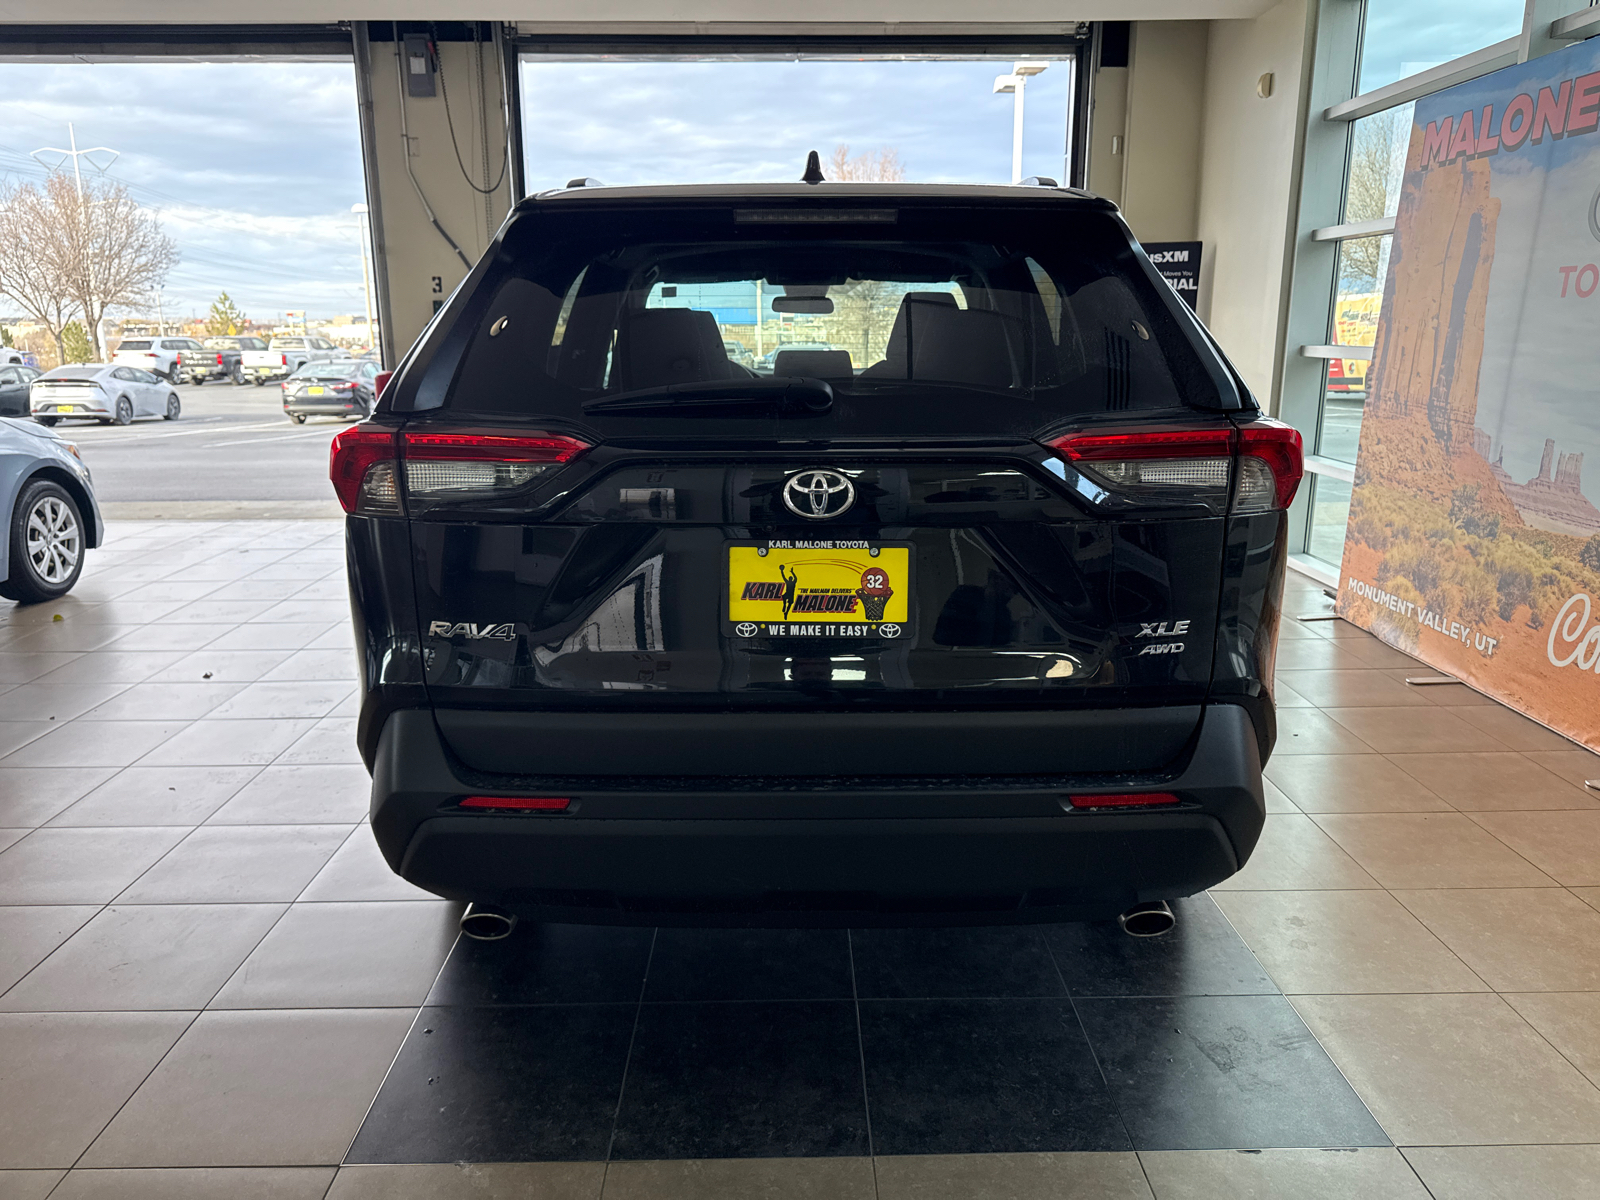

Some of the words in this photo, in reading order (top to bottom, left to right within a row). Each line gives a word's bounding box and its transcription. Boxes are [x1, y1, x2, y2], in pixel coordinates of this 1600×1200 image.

[431, 276, 443, 293] 3
[1558, 263, 1600, 299] TO
[768, 540, 793, 549] KARL
[795, 540, 833, 549] MALONE
[835, 540, 870, 549] TOYOTA
[866, 574, 884, 589] 32
[741, 581, 785, 601] KARL
[791, 594, 859, 614] MALONE
[1347, 577, 1415, 618] MONUMENT
[1416, 606, 1471, 648] VALLEY,
[1474, 632, 1498, 656] UT
[427, 620, 517, 642] RAV4
[768, 624, 786, 636] WE
[790, 624, 822, 636] MAKE
[826, 624, 836, 636] IT
[840, 624, 868, 637] EASY
[1134, 620, 1191, 638] XLE
[1138, 642, 1185, 656] AWD
